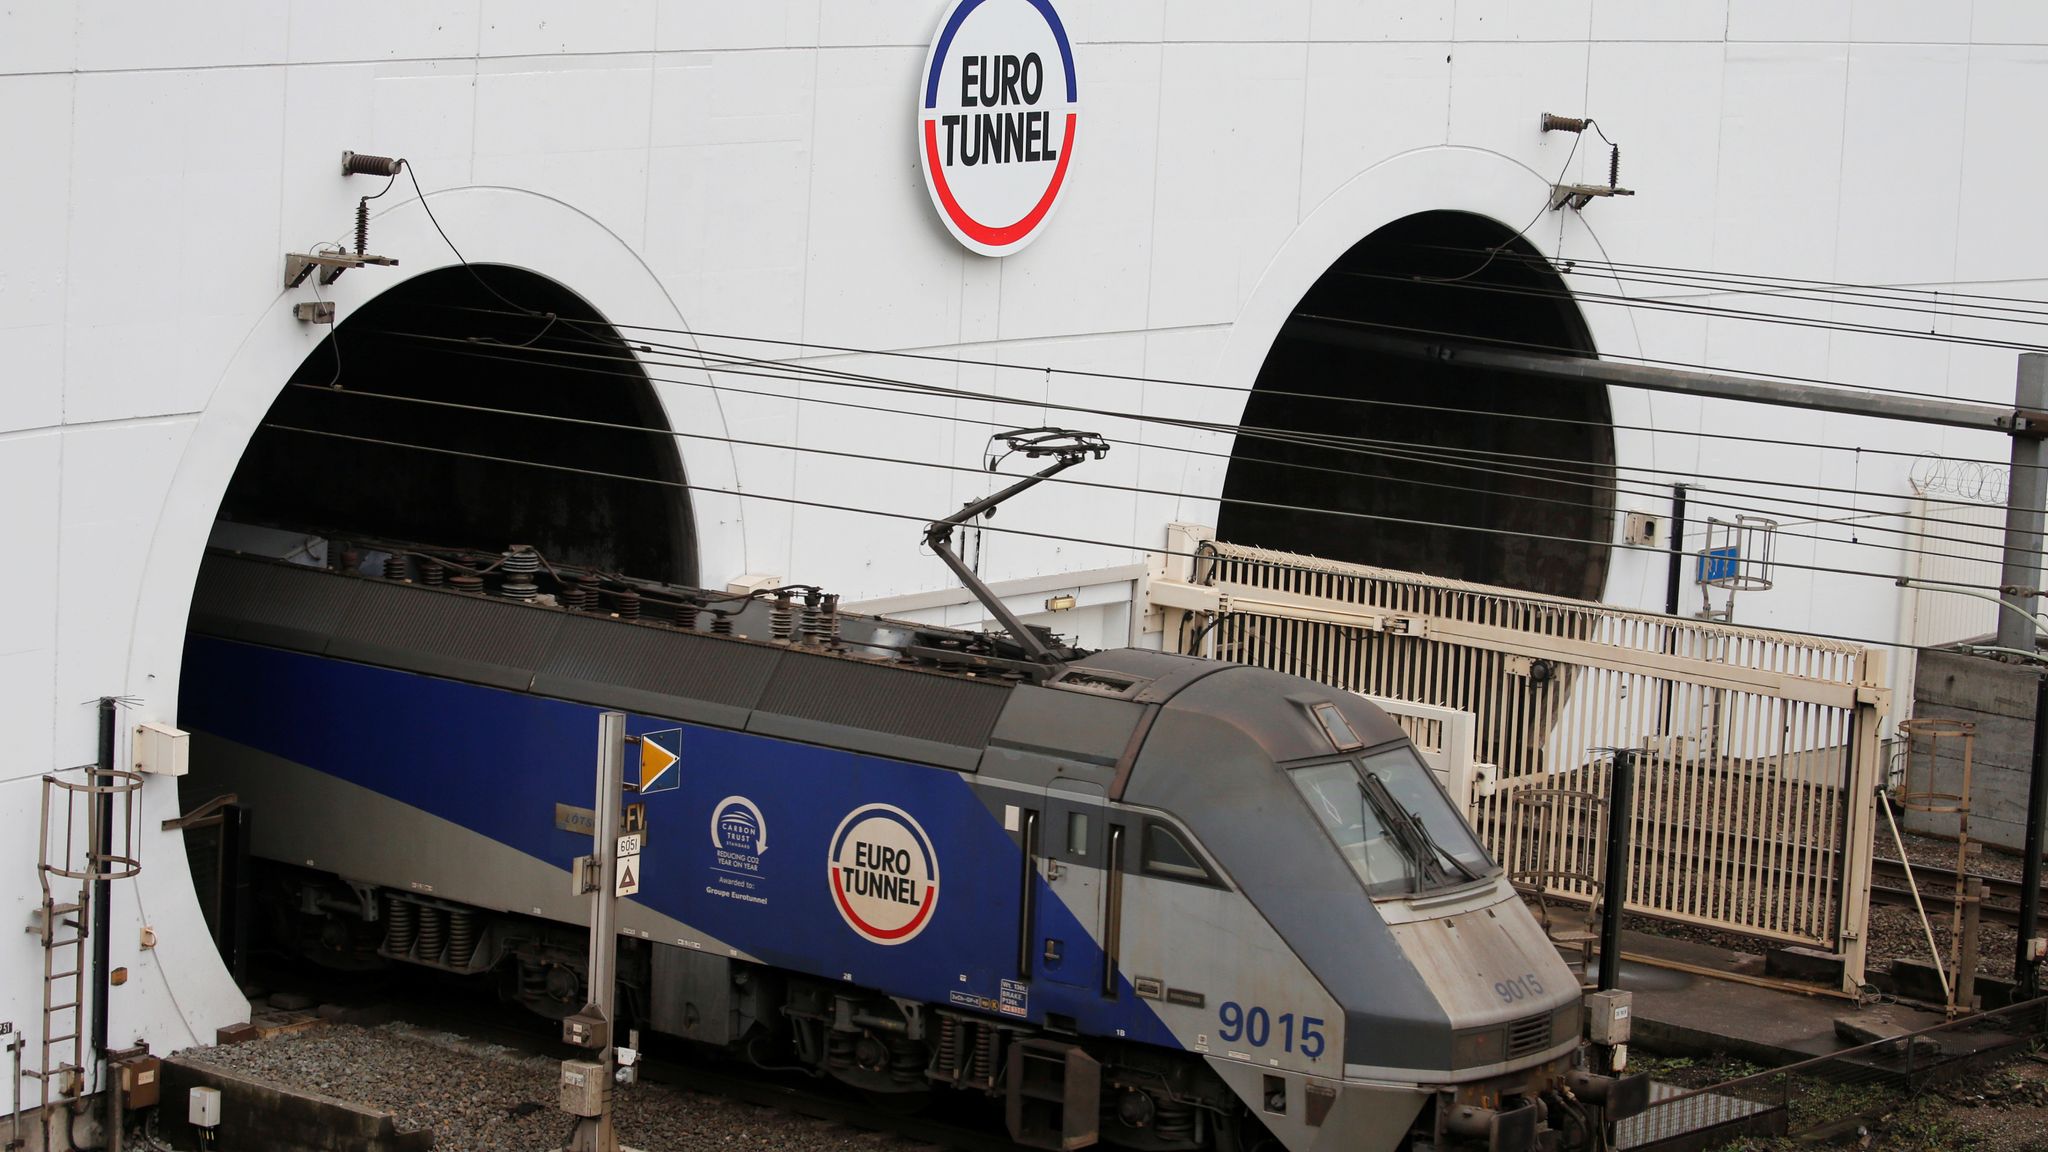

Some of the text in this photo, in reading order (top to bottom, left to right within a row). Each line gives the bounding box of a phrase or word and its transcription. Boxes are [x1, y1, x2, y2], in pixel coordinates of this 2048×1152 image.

[961, 52, 1043, 107] EURO
[942, 111, 1056, 167] TUNNEL
[722, 823, 756, 835] CARBON
[727, 832, 750, 842] TRUST
[620, 838, 638, 852] 6051
[717, 850, 746, 862] REDUCING
[718, 858, 758, 871] YEAR ON YEAR
[855, 841, 911, 875] EURO
[719, 877, 745, 888] Awarded
[843, 867, 920, 907] TUNNEL
[706, 886, 768, 905] Groupe Eurotunnel
[1494, 973, 1544, 1004] 9015
[1218, 1001, 1325, 1059] 9015
